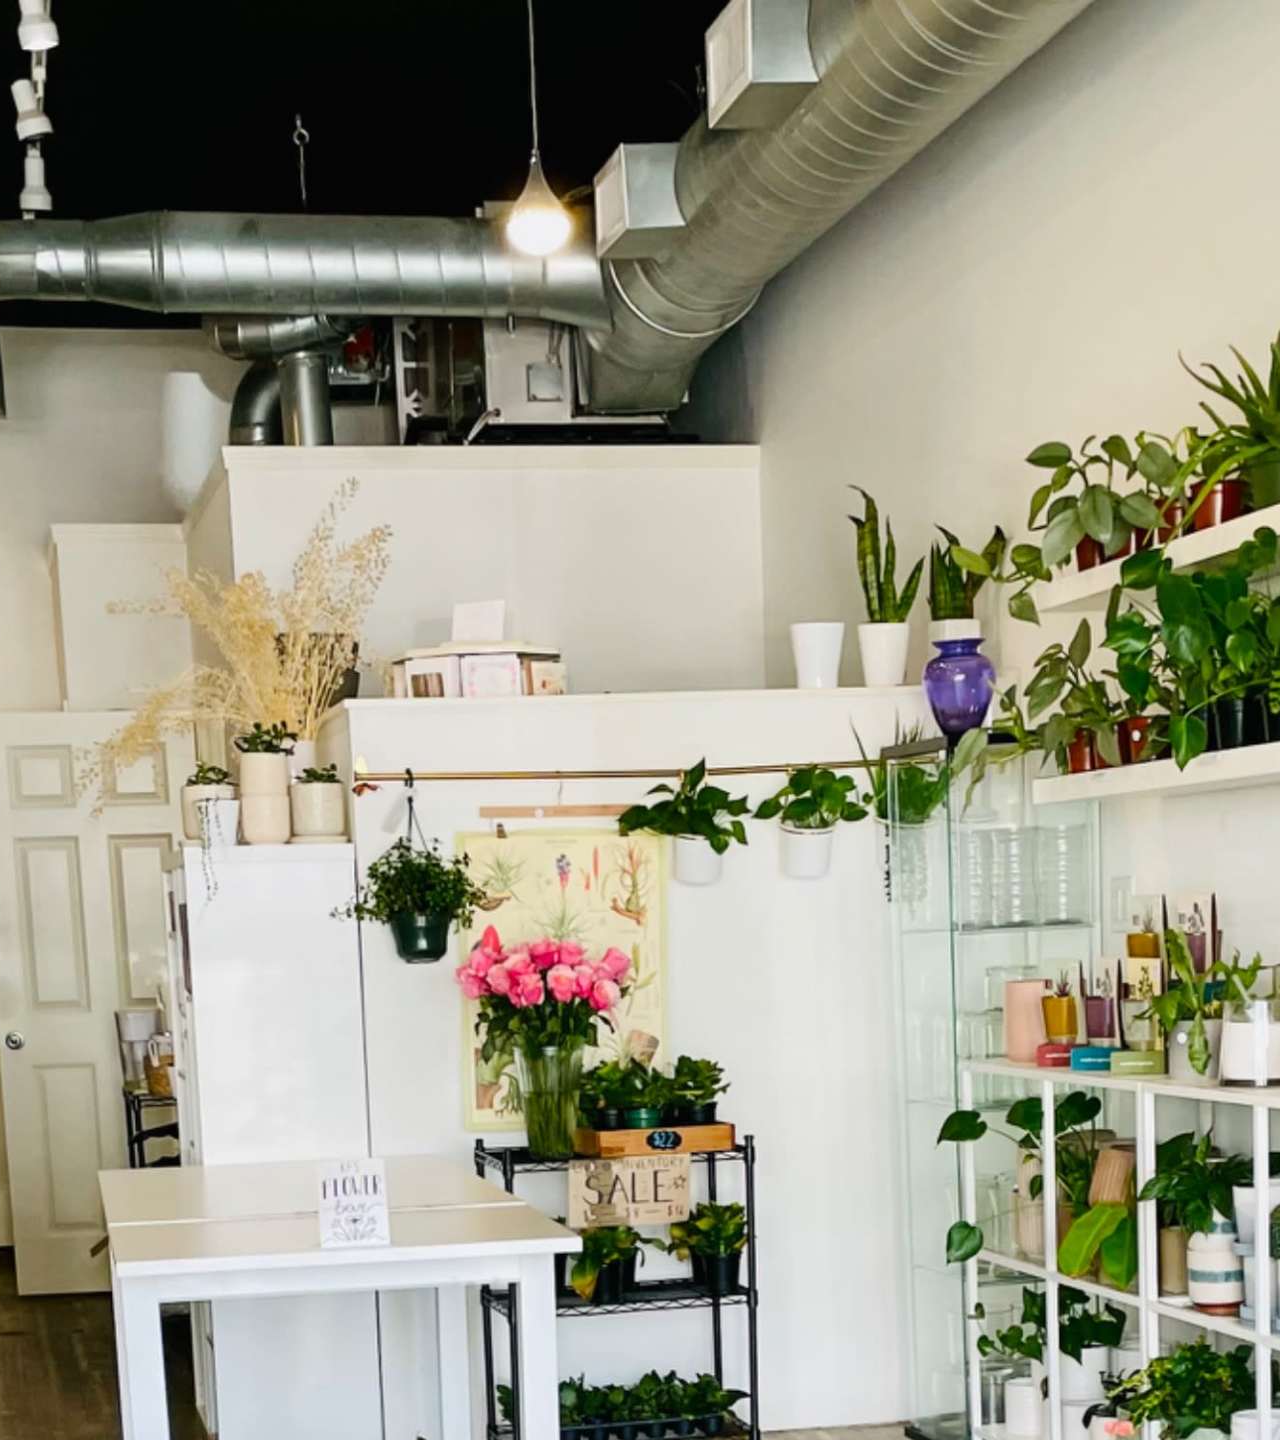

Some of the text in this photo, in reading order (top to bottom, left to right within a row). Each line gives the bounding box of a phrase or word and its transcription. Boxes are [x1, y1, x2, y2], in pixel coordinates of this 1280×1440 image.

[653, 1132, 675, 1147] $22
[322, 1175, 382, 1199] FLOWER
[583, 1169, 674, 1204] SALE
